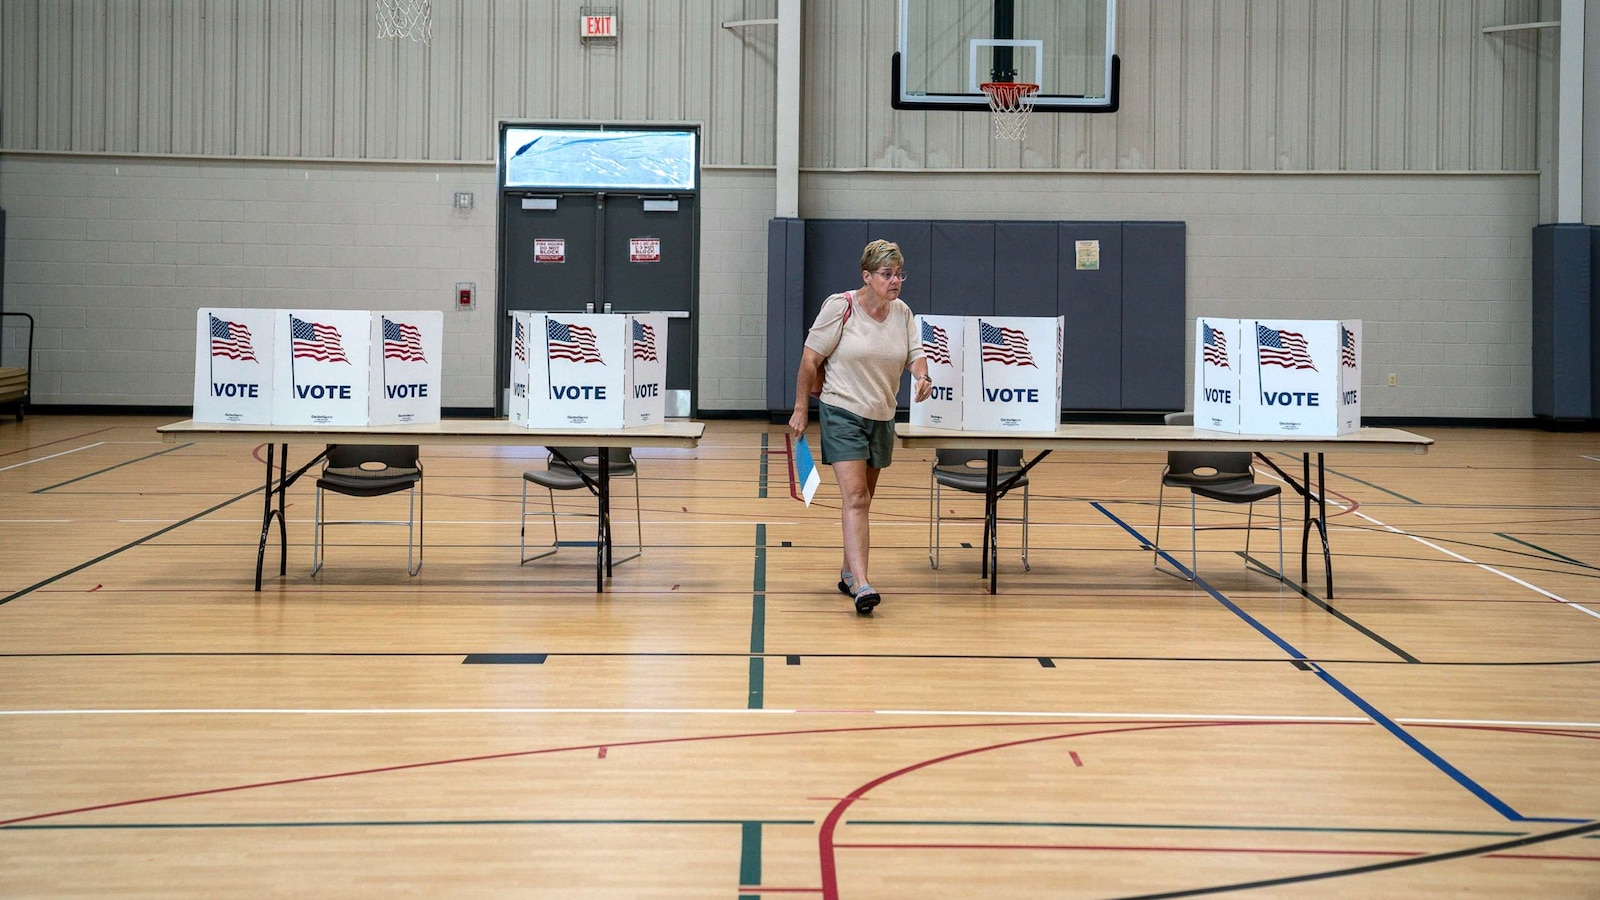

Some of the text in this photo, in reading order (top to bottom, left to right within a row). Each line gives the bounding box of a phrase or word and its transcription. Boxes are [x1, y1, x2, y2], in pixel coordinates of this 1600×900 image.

[588, 17, 610, 34] EXIT
[213, 383, 258, 398] VOTE
[296, 385, 351, 399] VOTE
[387, 384, 428, 399] VOTE
[552, 386, 606, 400] VOTE
[634, 383, 658, 399] VOTE
[931, 386, 953, 401] OTE
[986, 388, 1039, 402] VOTE
[1205, 388, 1231, 404] VOTE
[1342, 390, 1357, 405] VOTE
[1263, 392, 1319, 406] VOTE
